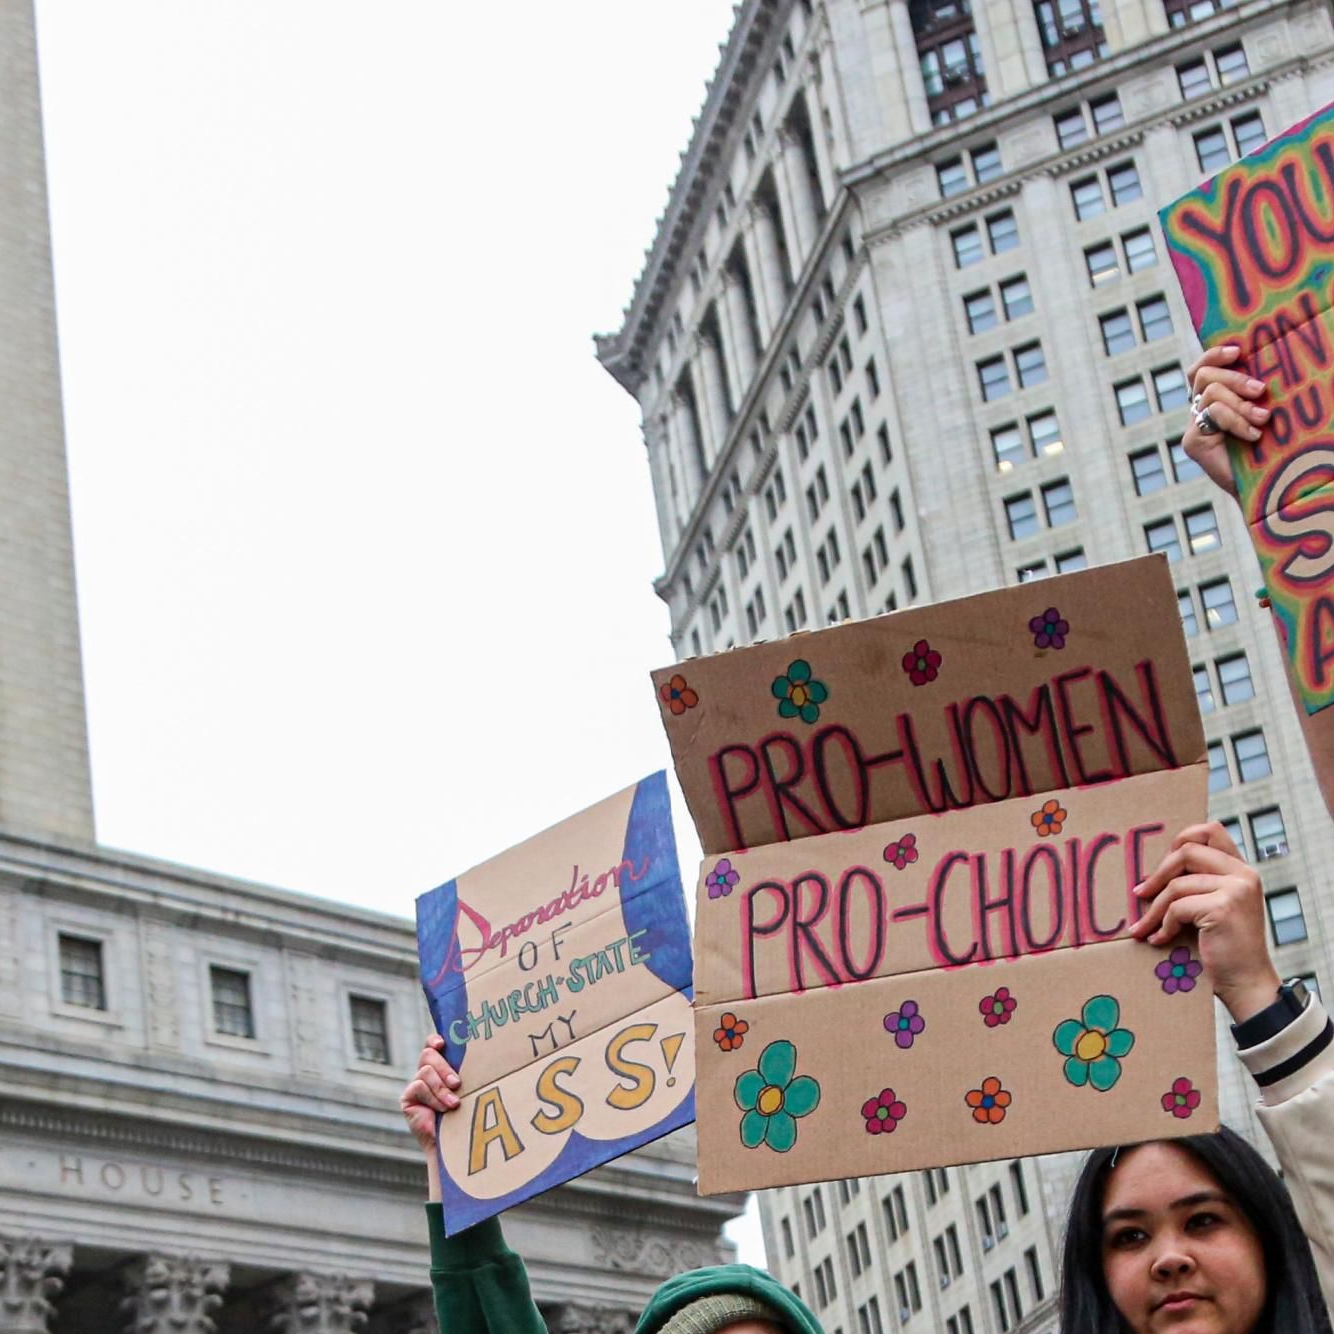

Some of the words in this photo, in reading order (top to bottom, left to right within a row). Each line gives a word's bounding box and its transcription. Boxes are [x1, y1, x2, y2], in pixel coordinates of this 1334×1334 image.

[1223, 291, 1327, 388] AN
[1251, 384, 1324, 464] OU
[707, 660, 1181, 854] PRO-WOMEN
[518, 921, 572, 971] OF
[528, 1009, 577, 1057] MY
[467, 1022, 687, 1176] ASS!
[58, 1157, 224, 1206] HOUSE
